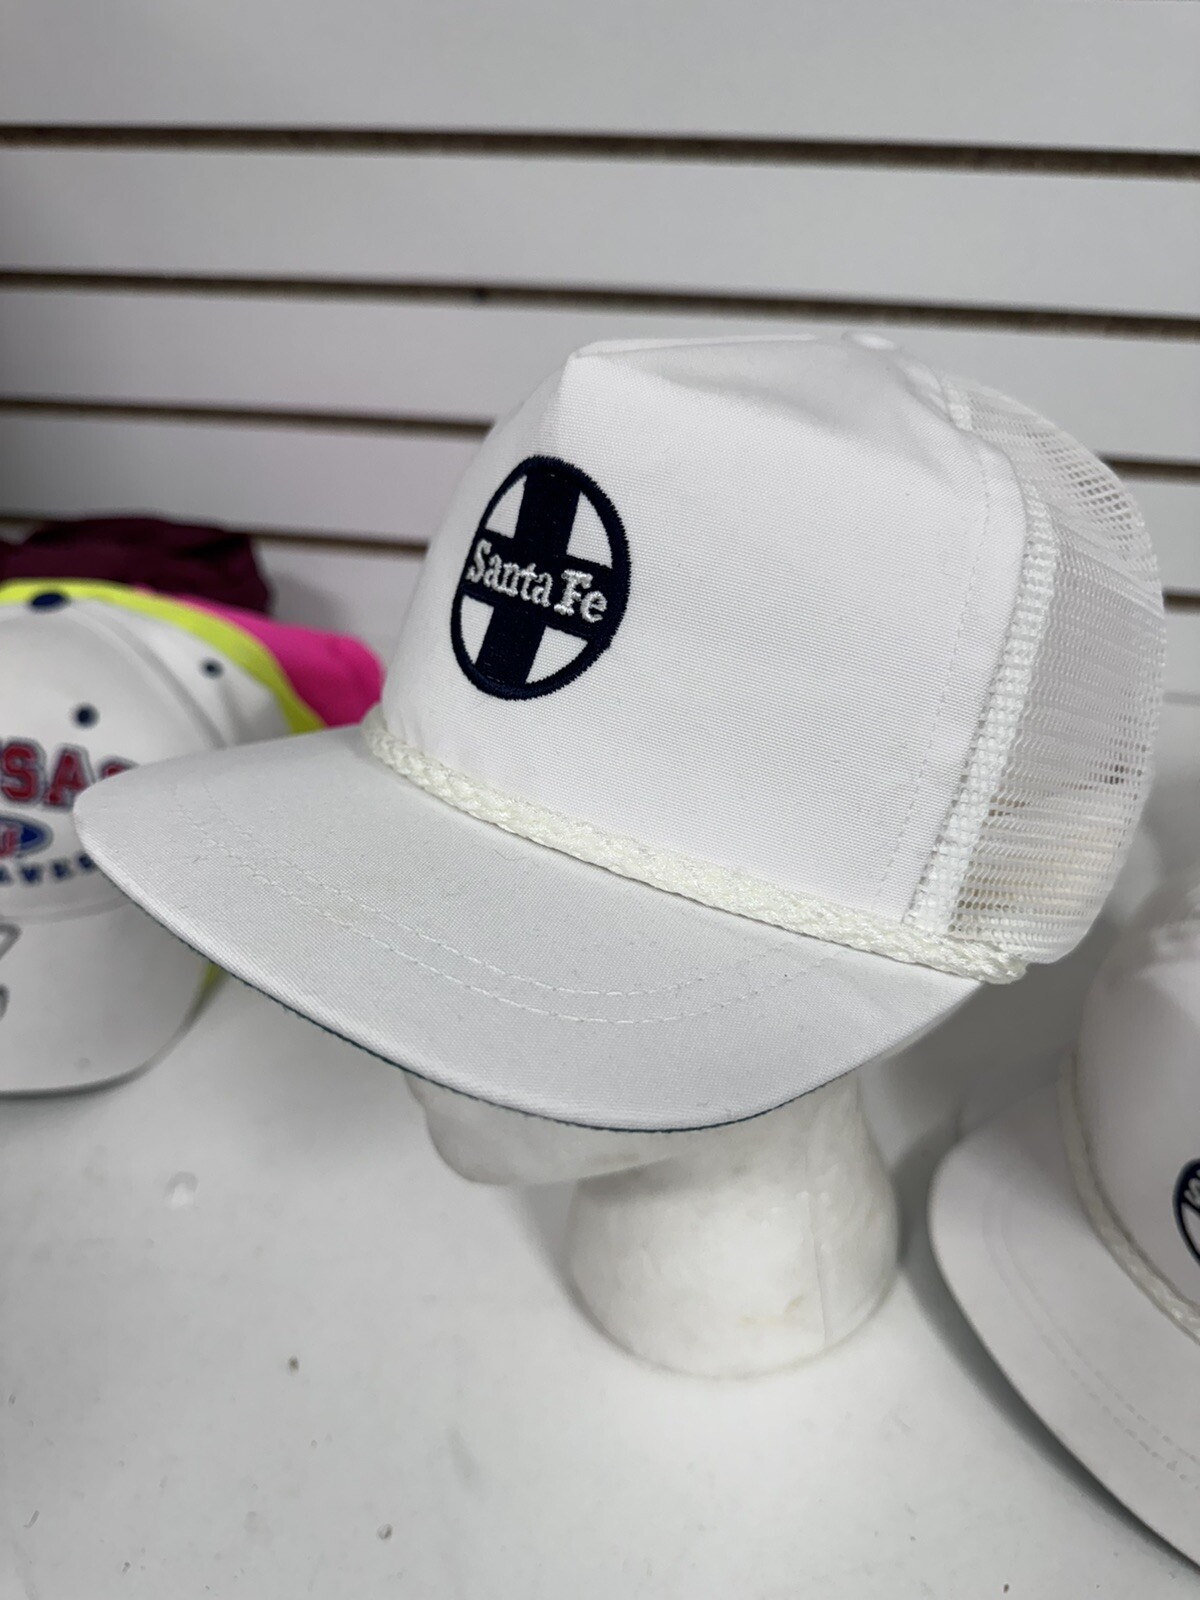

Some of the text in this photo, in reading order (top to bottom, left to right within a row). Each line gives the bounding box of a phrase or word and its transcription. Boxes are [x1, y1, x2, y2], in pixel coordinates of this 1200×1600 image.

[466, 538, 607, 623] Santa Fe
[0, 738, 136, 811] SA
